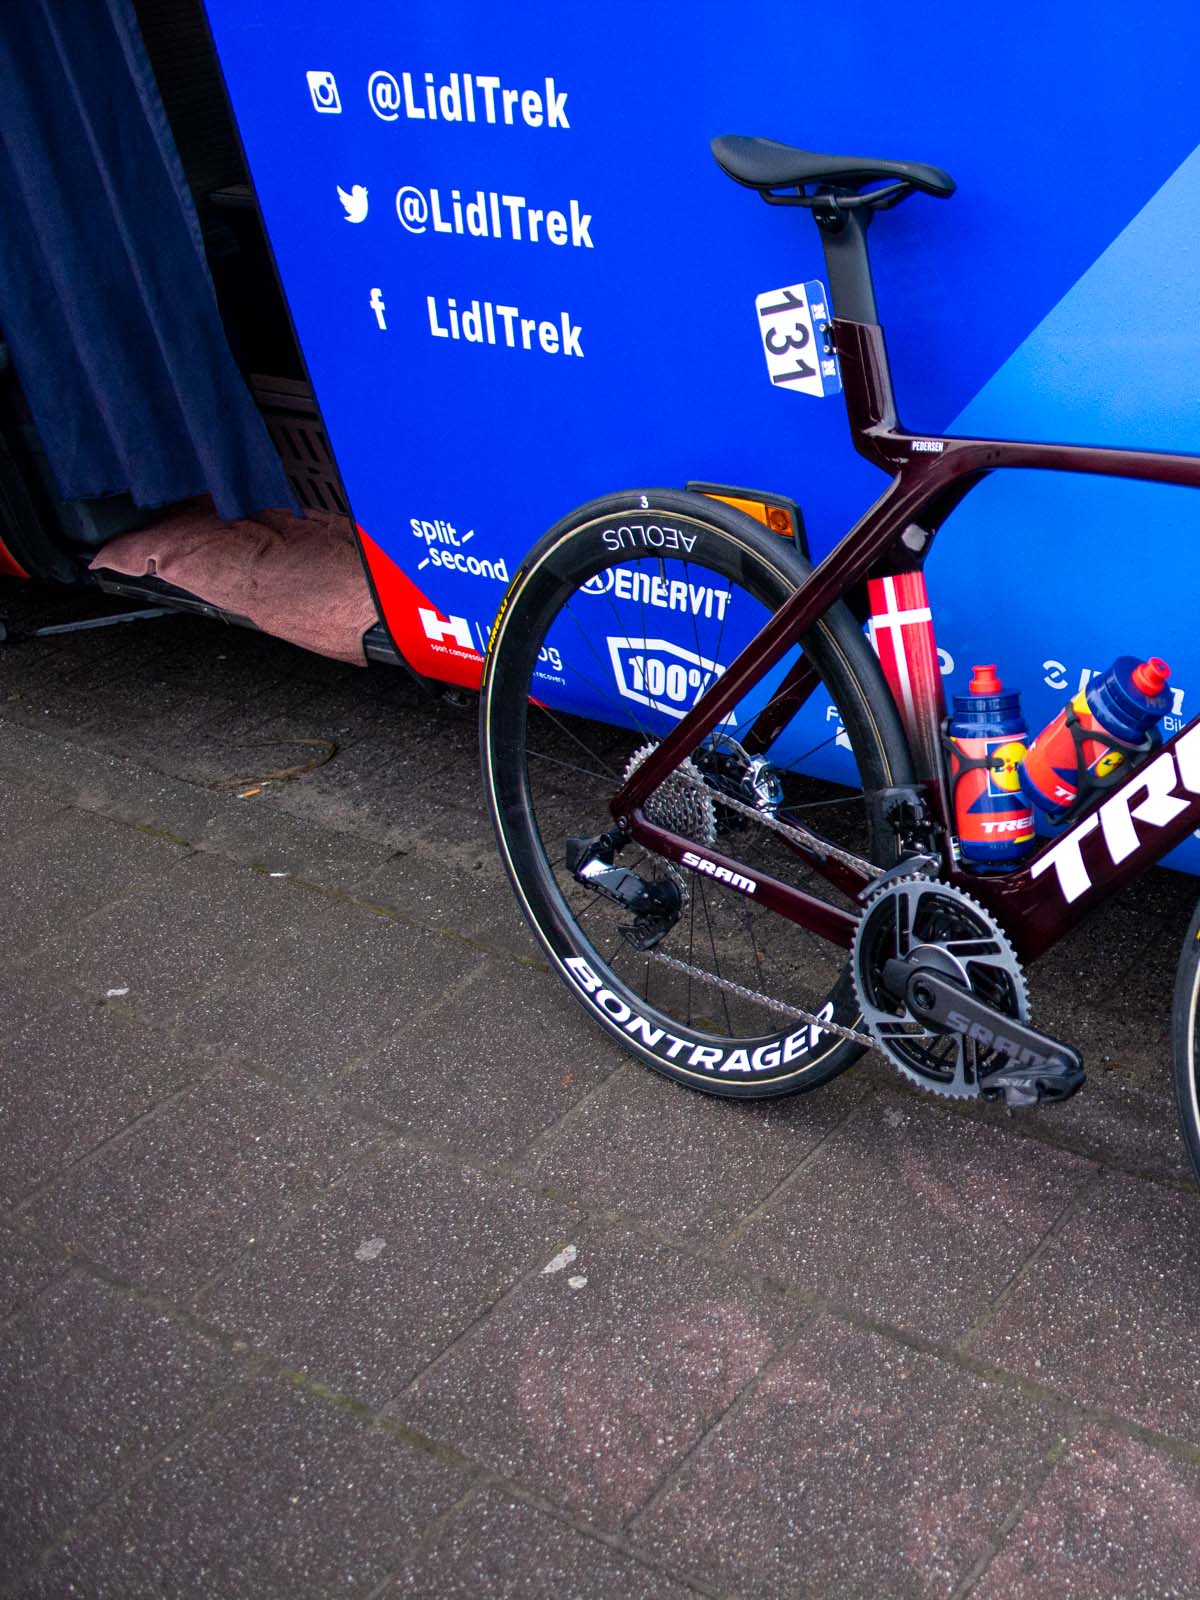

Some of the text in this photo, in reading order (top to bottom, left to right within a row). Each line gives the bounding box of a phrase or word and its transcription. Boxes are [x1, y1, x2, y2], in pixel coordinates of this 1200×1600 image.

[368, 70, 570, 128] @LidlTrek
[396, 186, 594, 248] @LidlTrek
[427, 296, 584, 357] LidlTrek
[759, 290, 816, 384] 131
[912, 441, 944, 452] PEDERSEN
[410, 518, 461, 547] split
[602, 525, 697, 553] AEOLUS
[429, 547, 510, 582] second
[682, 851, 757, 894] SRAM
[554, 957, 835, 1072] BONTRAGER
